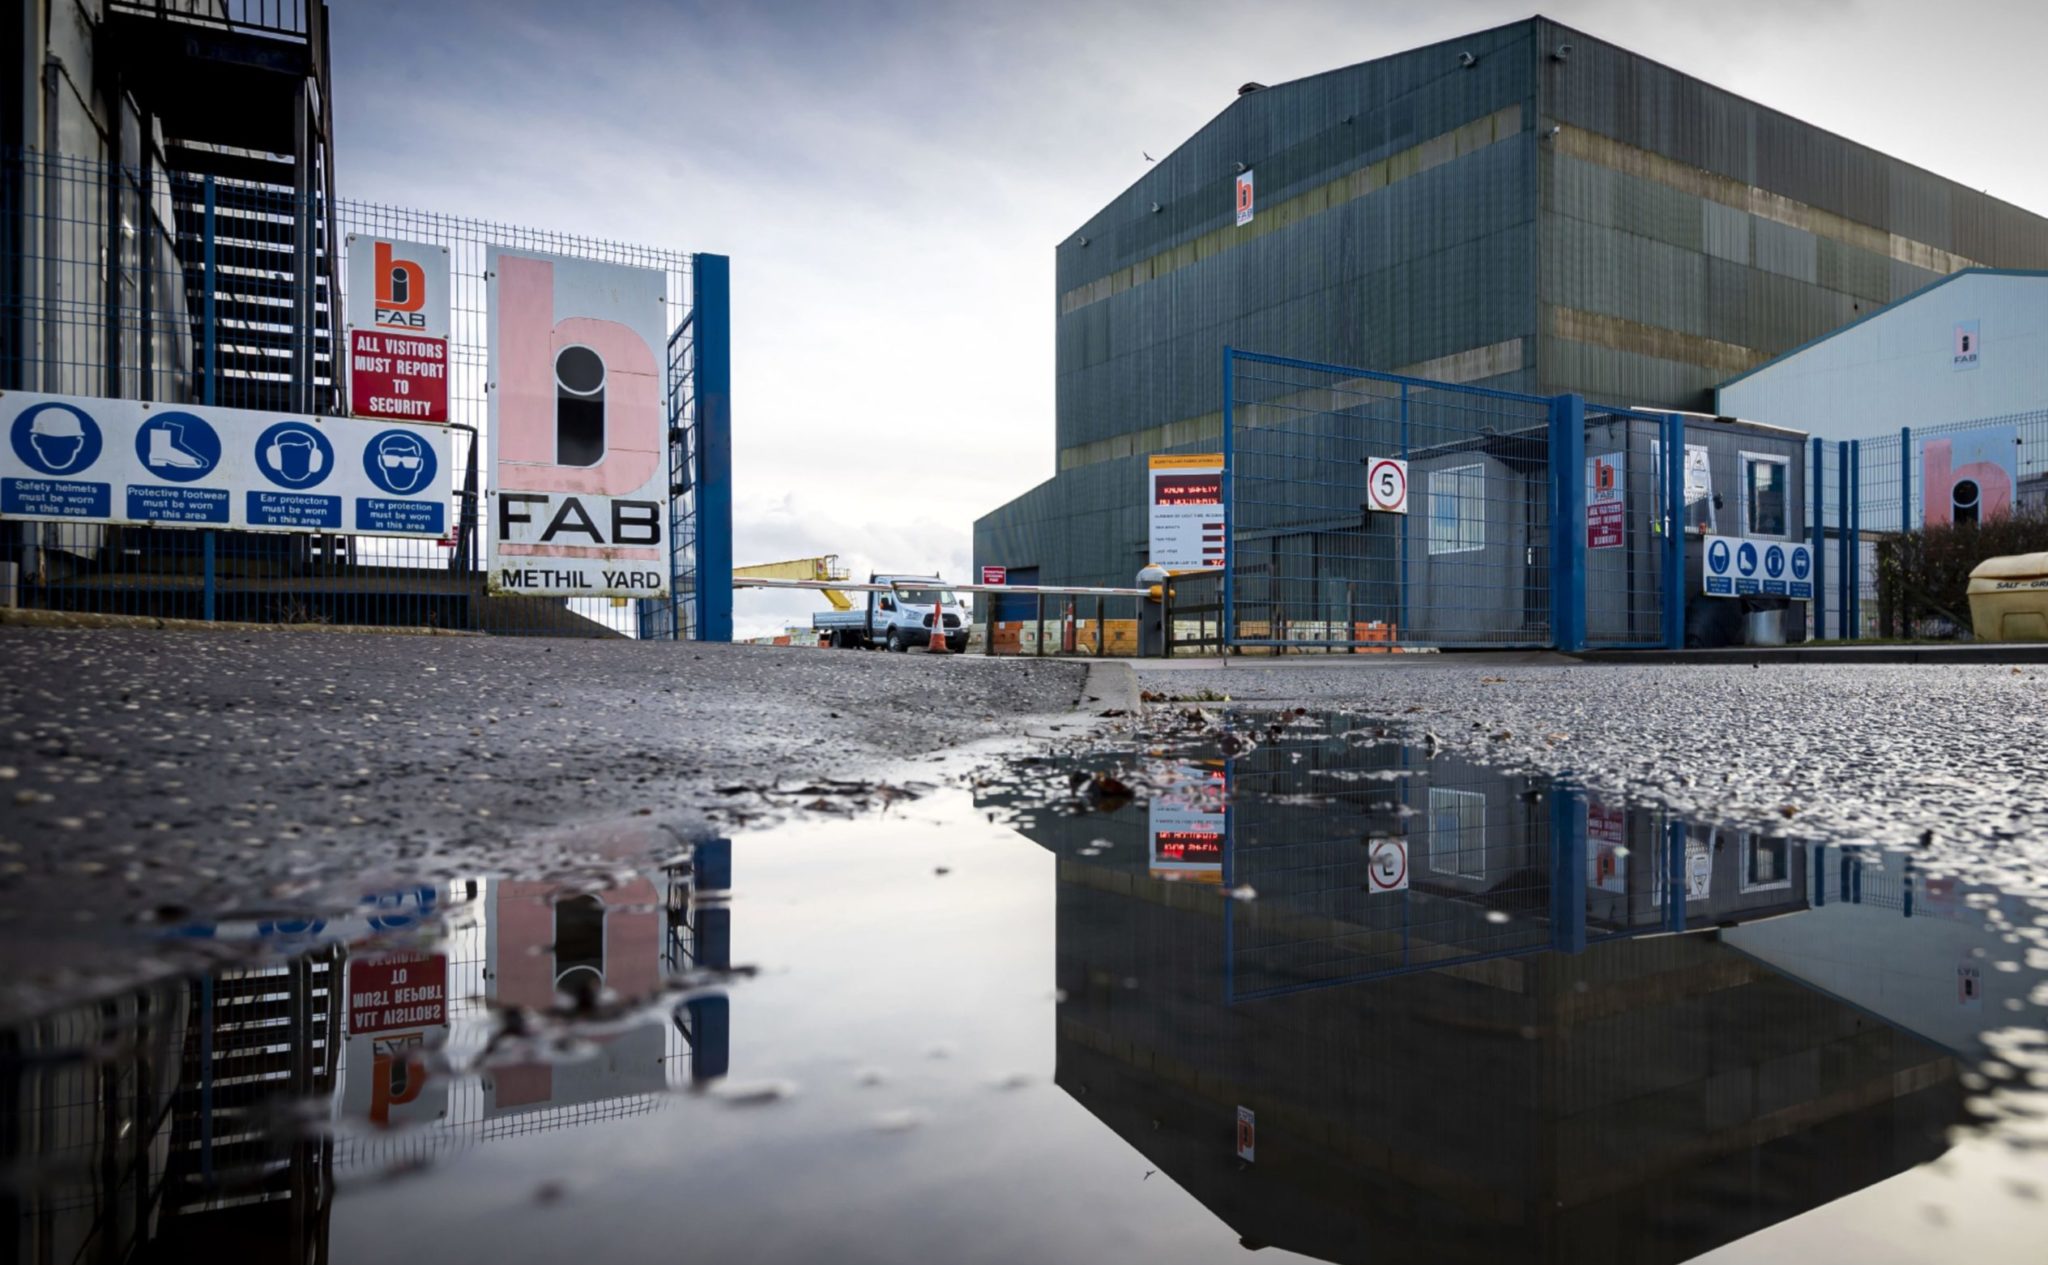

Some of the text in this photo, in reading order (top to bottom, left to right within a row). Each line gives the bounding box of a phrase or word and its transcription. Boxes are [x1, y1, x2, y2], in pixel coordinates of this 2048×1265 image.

[374, 308, 426, 327] FAB
[357, 336, 443, 359] ALL VISITORS
[1954, 354, 1977, 364] FAB
[354, 355, 444, 379] MUST REPORT
[393, 379, 409, 395] TO
[369, 396, 431, 416] SECURITY
[15, 480, 97, 494] Safety helmets
[1381, 473, 1394, 497] 5
[18, 493, 95, 504] must be worn
[128, 486, 228, 500] Protective footwear
[260, 493, 329, 506] Ear protectors
[25, 503, 88, 514] in this area
[143, 499, 214, 510] must be worn
[262, 505, 328, 516] must be worn
[368, 499, 433, 512] Eye protection
[150, 509, 207, 521] in this area
[268, 515, 322, 526] in this area
[370, 510, 431, 521] must be worn
[498, 492, 661, 545] FAB
[375, 520, 425, 531] in this area
[502, 569, 661, 589] METHIL YARD
[1996, 581, 2020, 590] SALT
